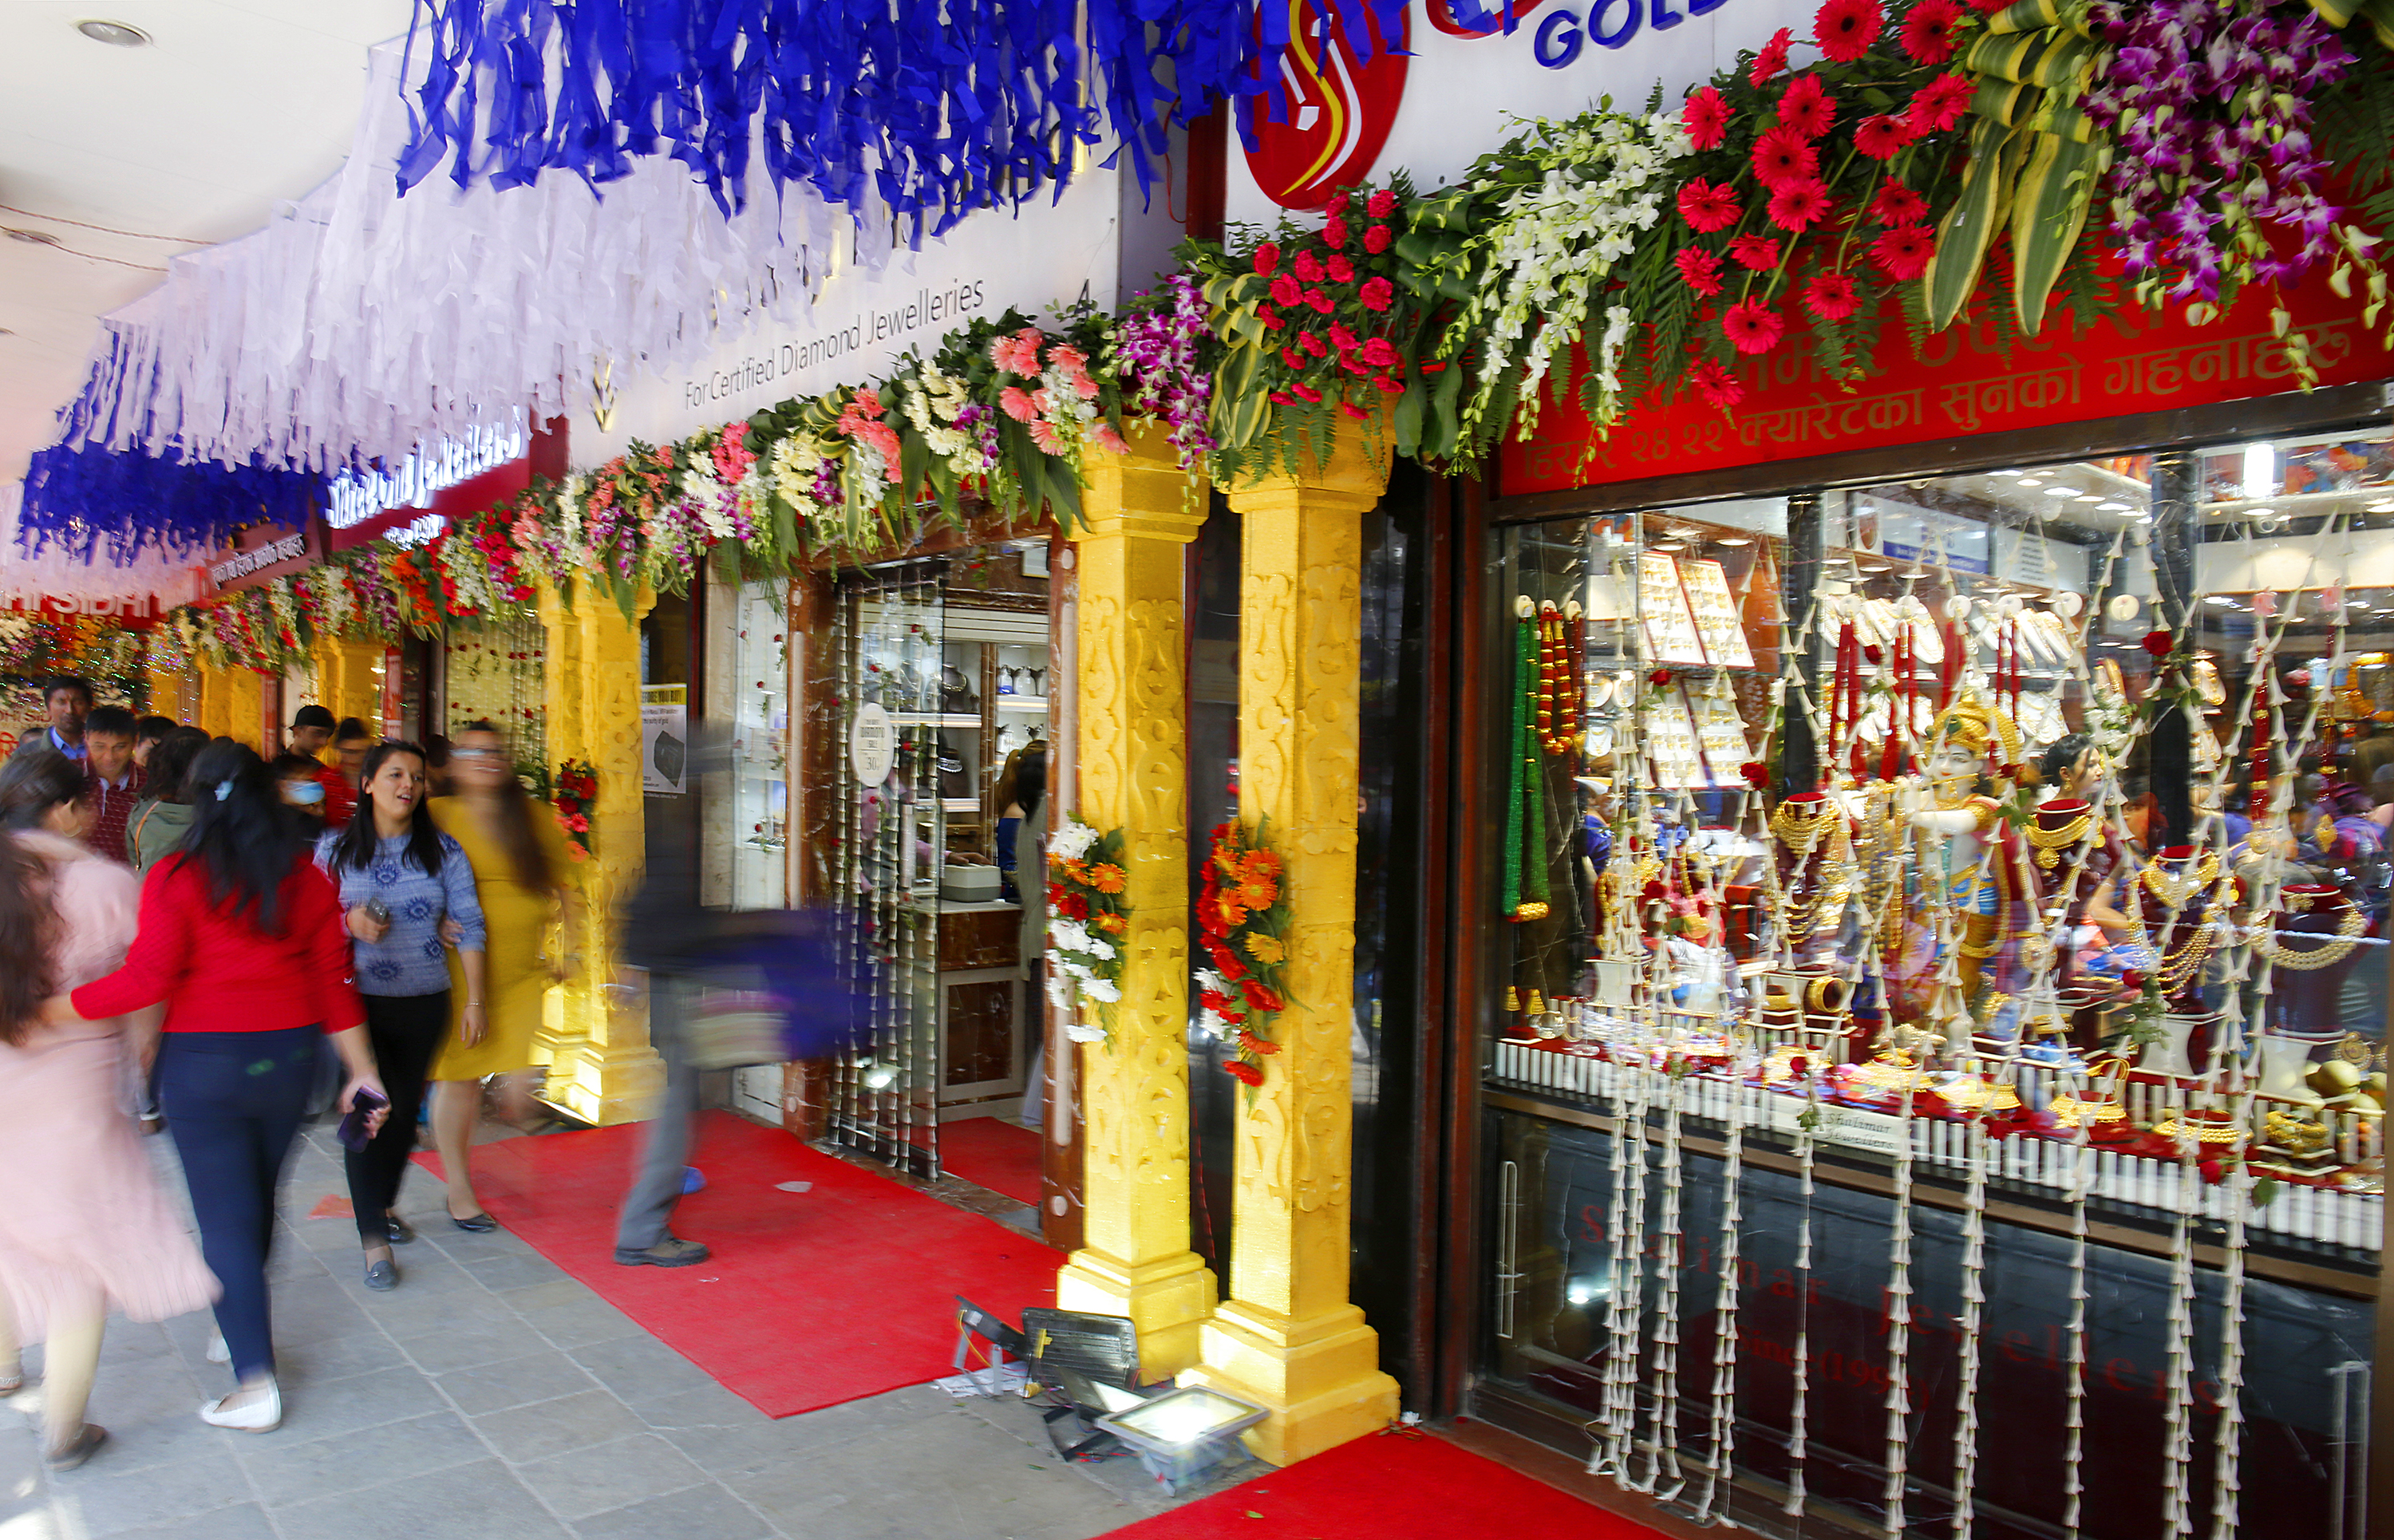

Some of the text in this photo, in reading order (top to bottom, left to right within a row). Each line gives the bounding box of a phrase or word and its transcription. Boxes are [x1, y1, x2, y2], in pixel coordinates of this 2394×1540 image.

[1535, 0, 1728, 70] GOL
[686, 278, 985, 411] For Certified Diamond Jewelleries
[1939, 352, 2085, 432] सुनको
[1823, 1128, 1894, 1150] Jewellers
[1826, 1112, 1892, 1135] Shalimar
